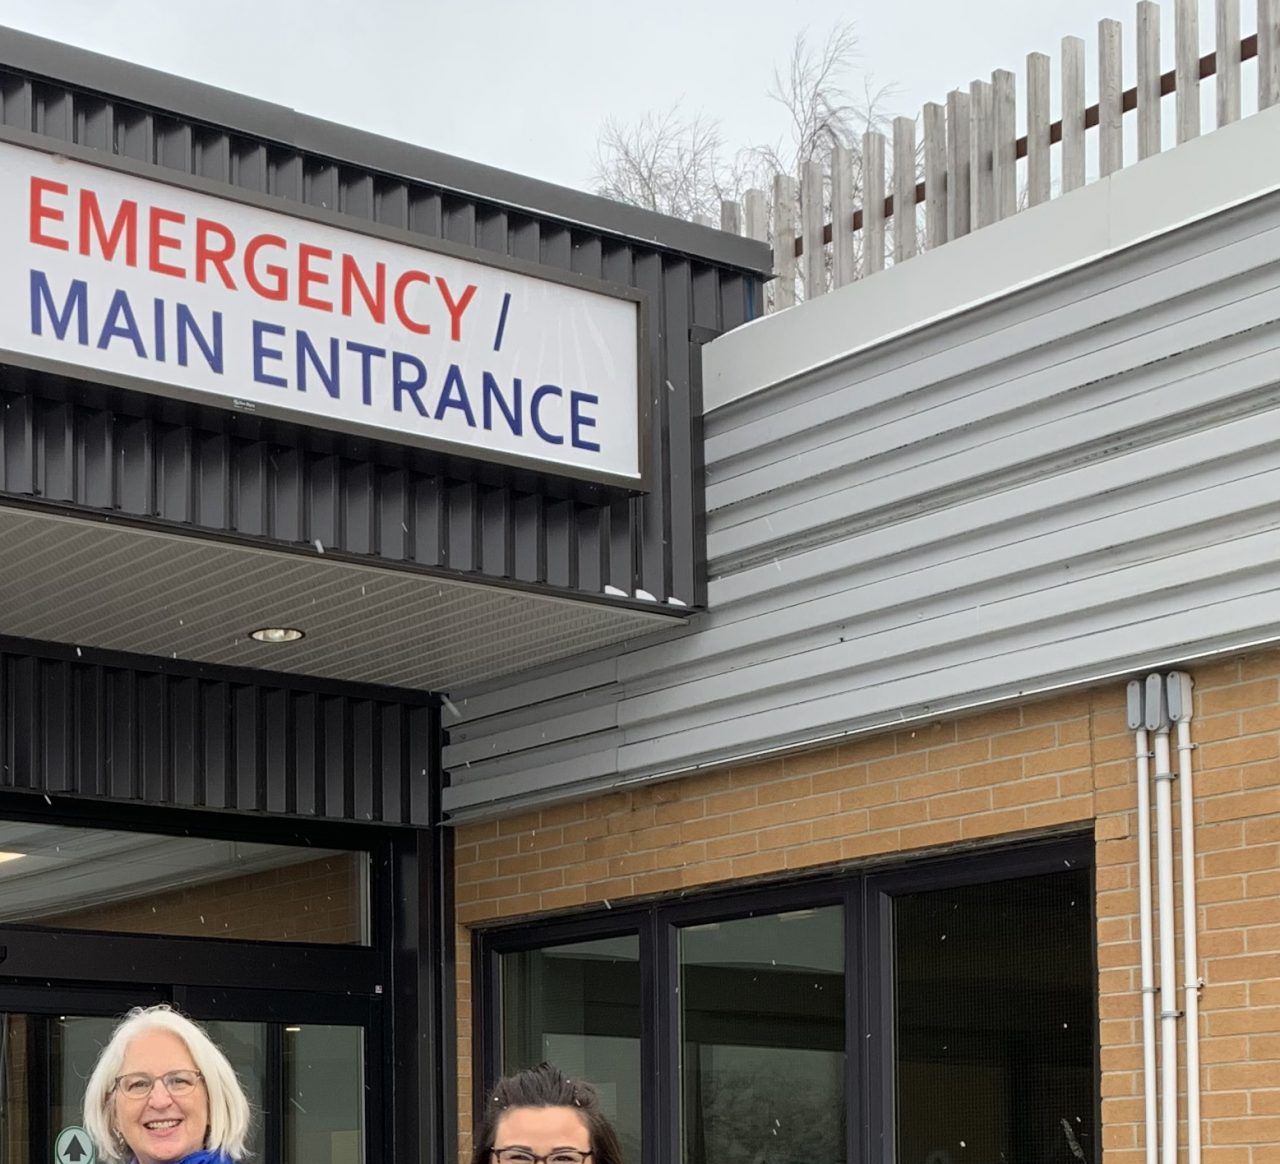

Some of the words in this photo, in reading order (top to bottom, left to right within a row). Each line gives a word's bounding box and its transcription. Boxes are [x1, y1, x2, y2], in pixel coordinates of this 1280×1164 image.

[28, 175, 477, 344] EMERGENCY
[492, 293, 511, 352] /
[30, 270, 225, 375] MAIN
[252, 320, 601, 453] ENTRANCE
